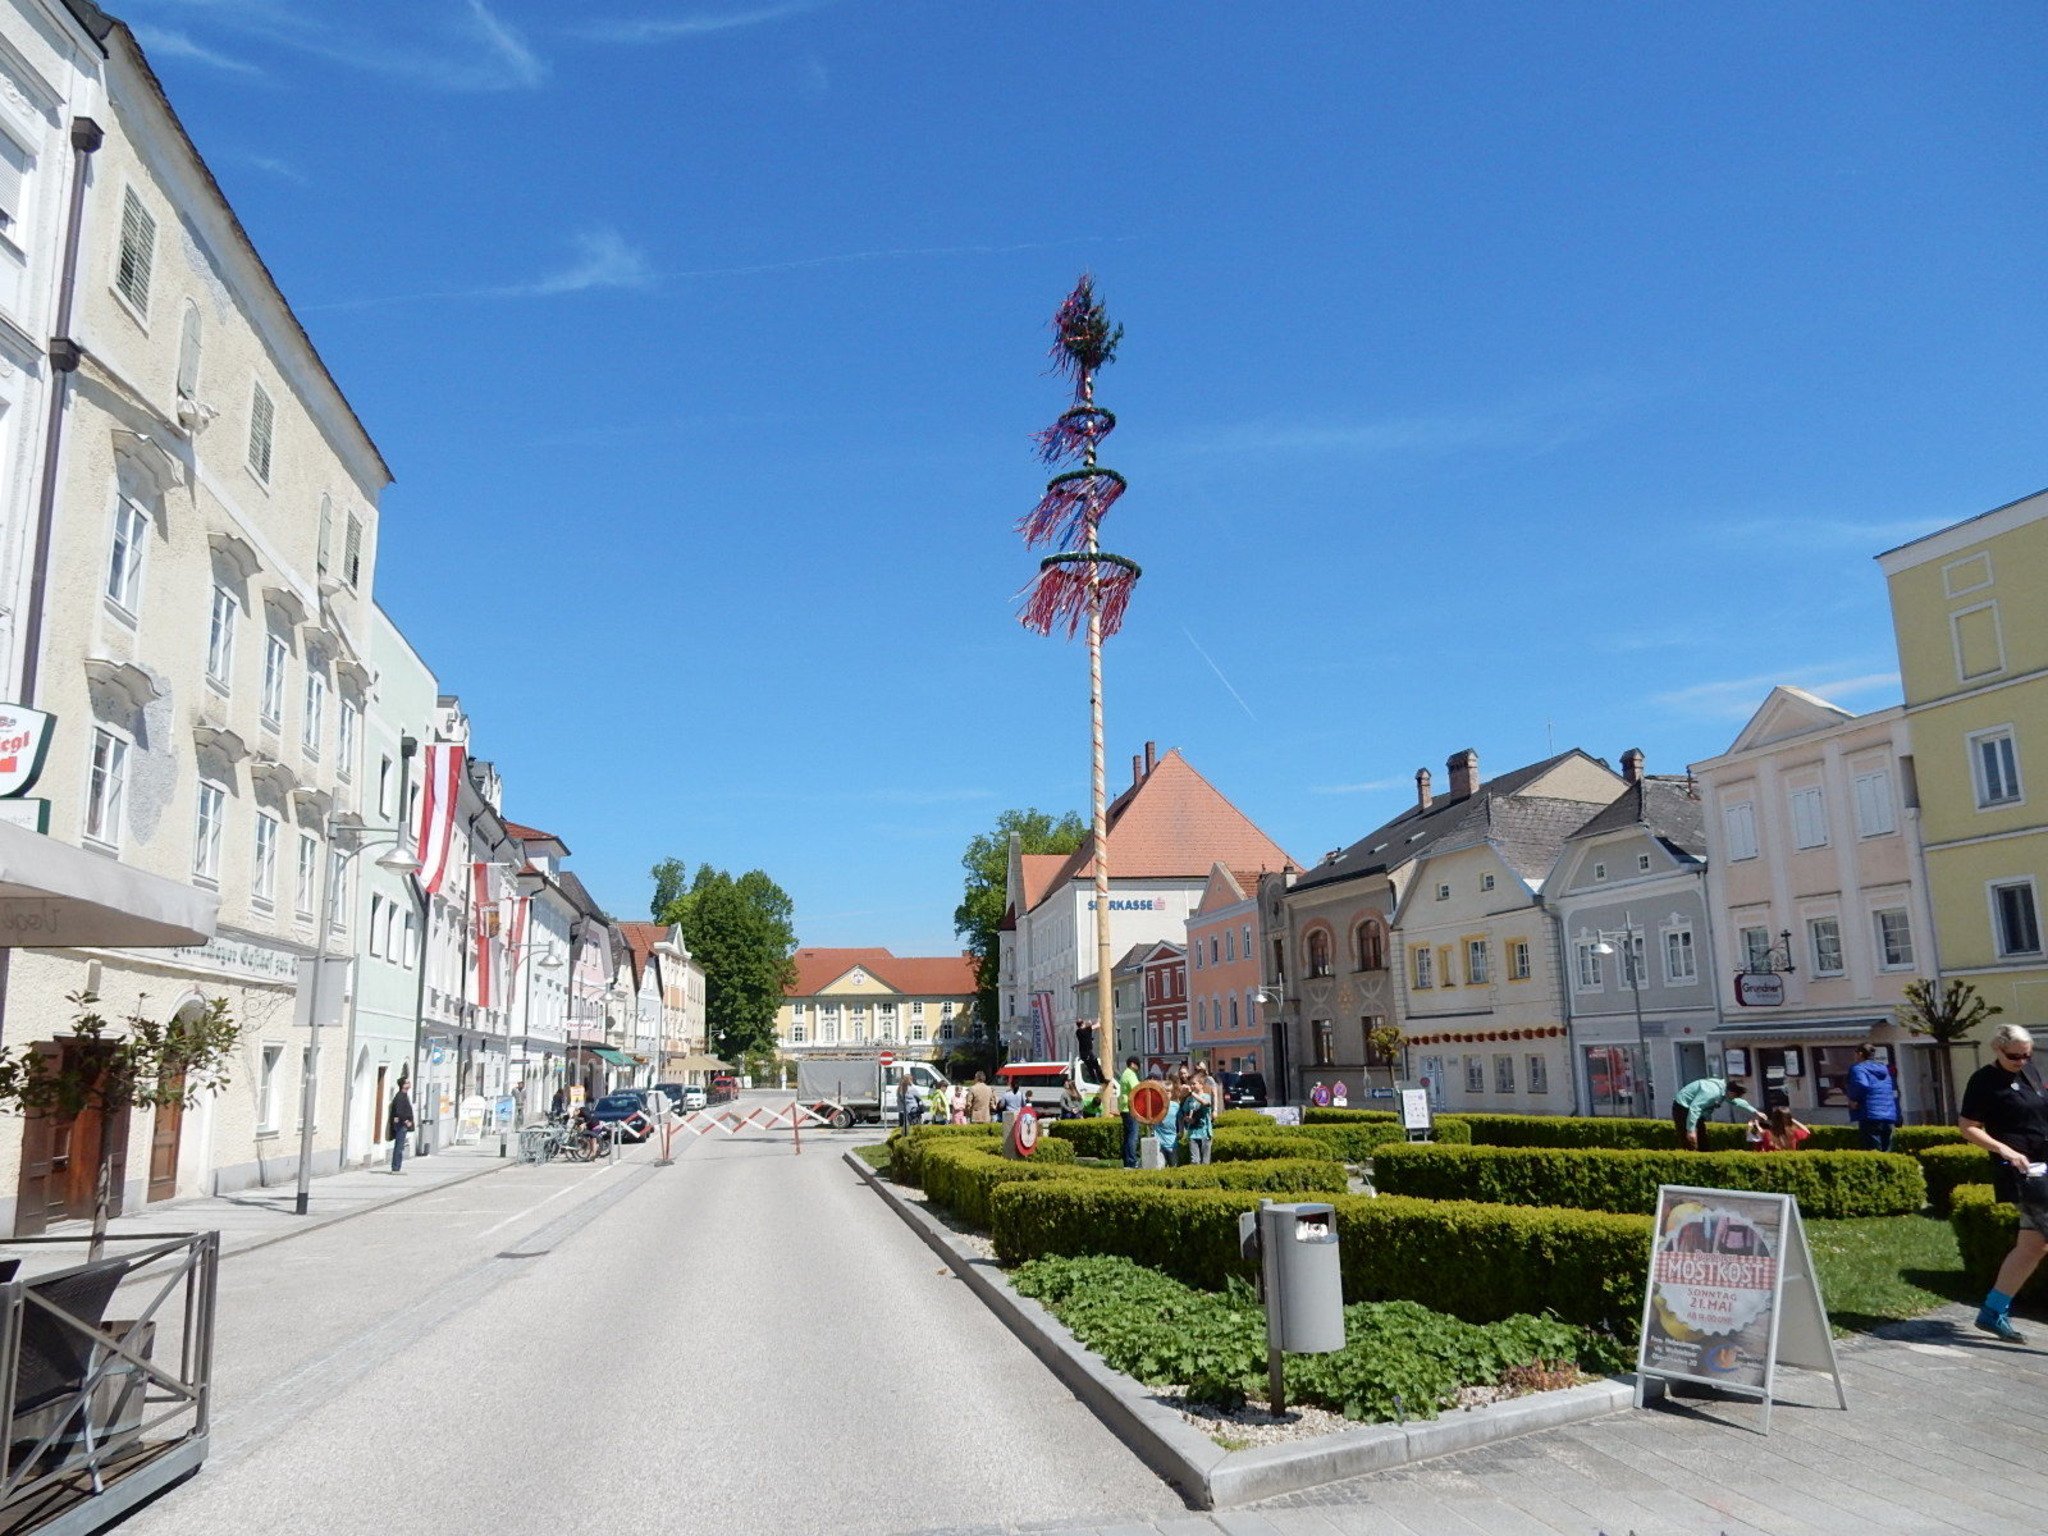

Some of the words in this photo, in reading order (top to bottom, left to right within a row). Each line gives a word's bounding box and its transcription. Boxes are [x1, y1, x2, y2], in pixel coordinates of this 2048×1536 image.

[1087, 899, 1153, 911] SRKASSE
[1667, 1258, 1764, 1284] MOSTKOST
[1687, 1287, 1737, 1301] SONNTAG
